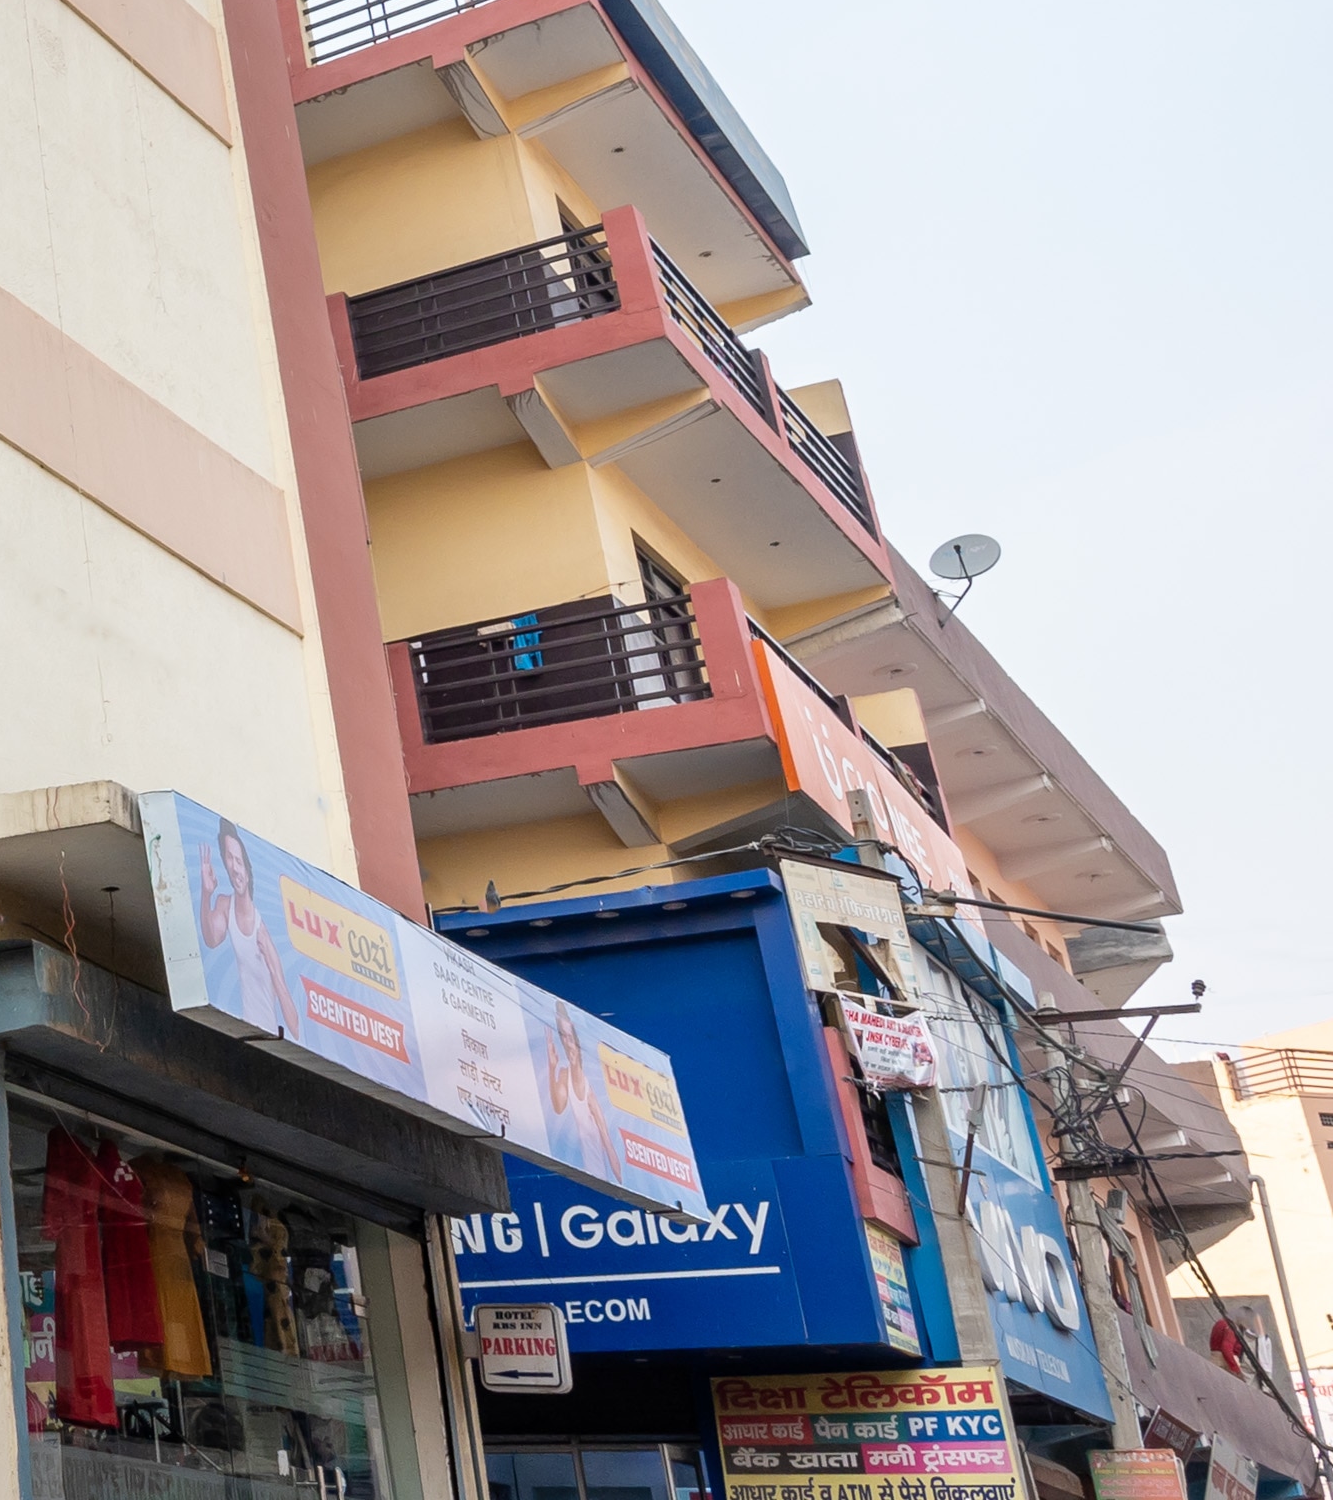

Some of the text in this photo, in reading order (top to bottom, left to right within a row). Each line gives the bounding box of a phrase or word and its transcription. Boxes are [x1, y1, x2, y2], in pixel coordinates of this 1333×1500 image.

[288, 900, 343, 949] LUX
[433, 962, 496, 1009] SAARI CENTRE
[308, 989, 402, 1053] SCENTED VEST
[449, 993, 497, 1031] GARMENTS
[604, 1063, 644, 1099] LUX
[625, 1138, 693, 1184] SCENTED VEST
[560, 1201, 770, 1255] Galaxy
[492, 1322, 542, 1330] RBS INN
[495, 1310, 535, 1320] HOTEL
[565, 1297, 652, 1324] ECOM
[481, 1337, 556, 1357] PARKING
[716, 1374, 995, 1411] दिक्षा टेलिकॉम
[723, 1414, 1002, 1441] आधार कार्ड पैन कार्ड PF KYC
[731, 1443, 1006, 1473] बैंक खाता मनी ट्रांसफर
[729, 1484, 778, 1500] आधार
[780, 1477, 815, 1500] कार्ड
[838, 1483, 872, 1500] ATM
[877, 1478, 894, 1500] से
[897, 1476, 927, 1500] पैसे
